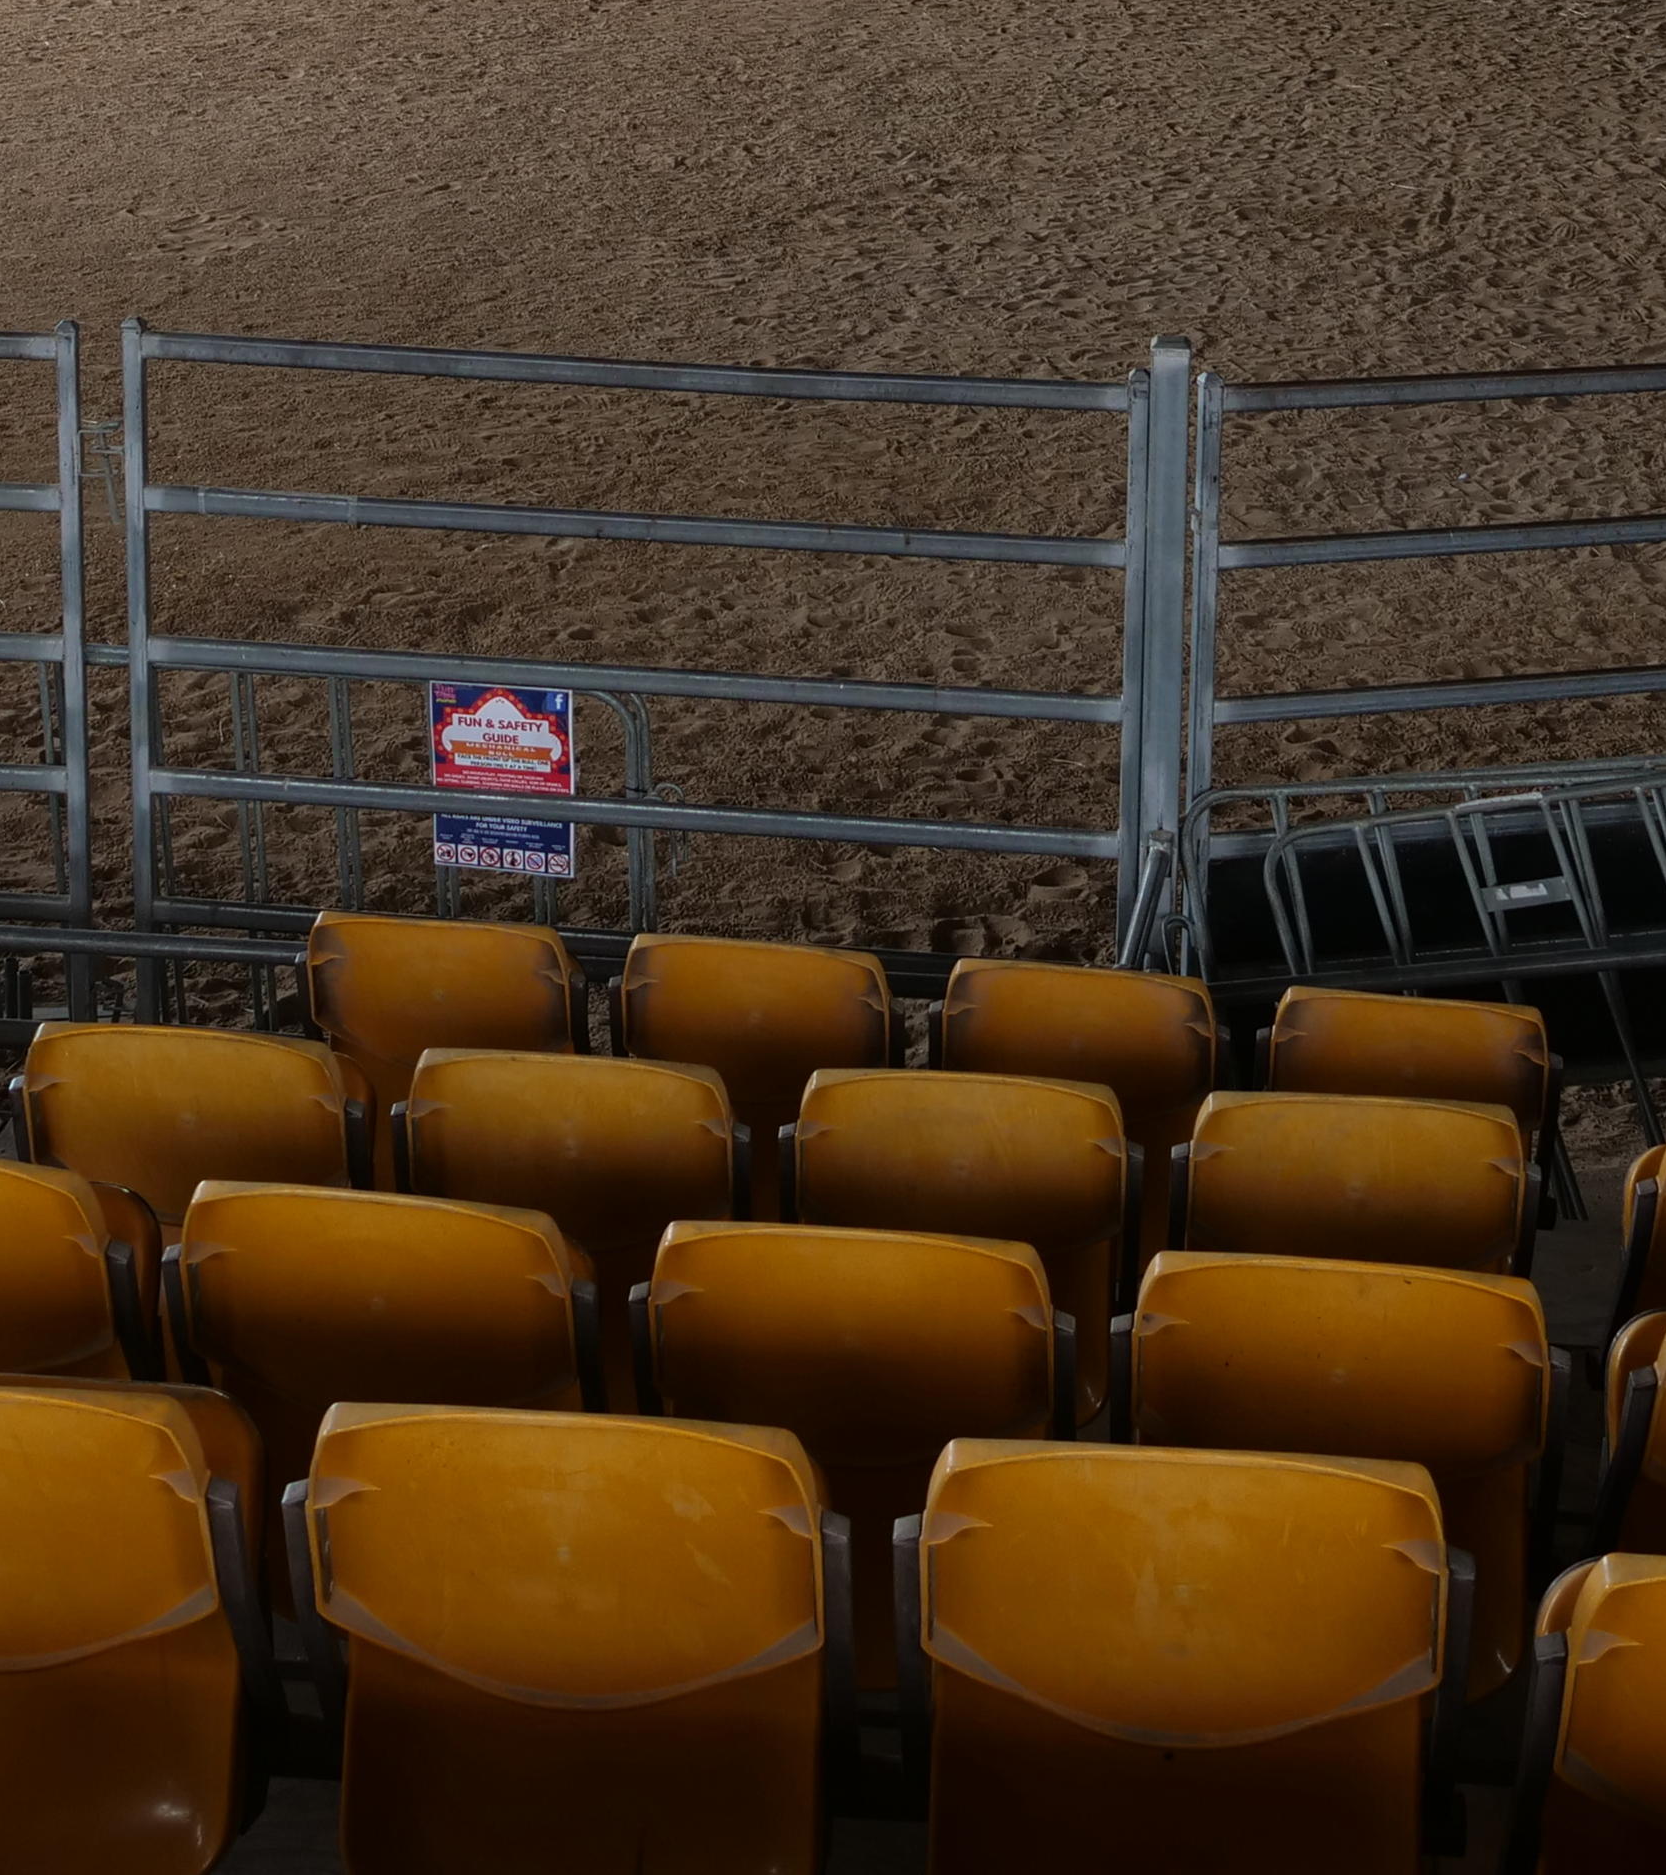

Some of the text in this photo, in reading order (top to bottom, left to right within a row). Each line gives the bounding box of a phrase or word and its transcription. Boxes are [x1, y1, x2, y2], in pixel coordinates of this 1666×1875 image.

[458, 716, 543, 733] FUN & SAFETY
[482, 732, 520, 745] GUIDE
